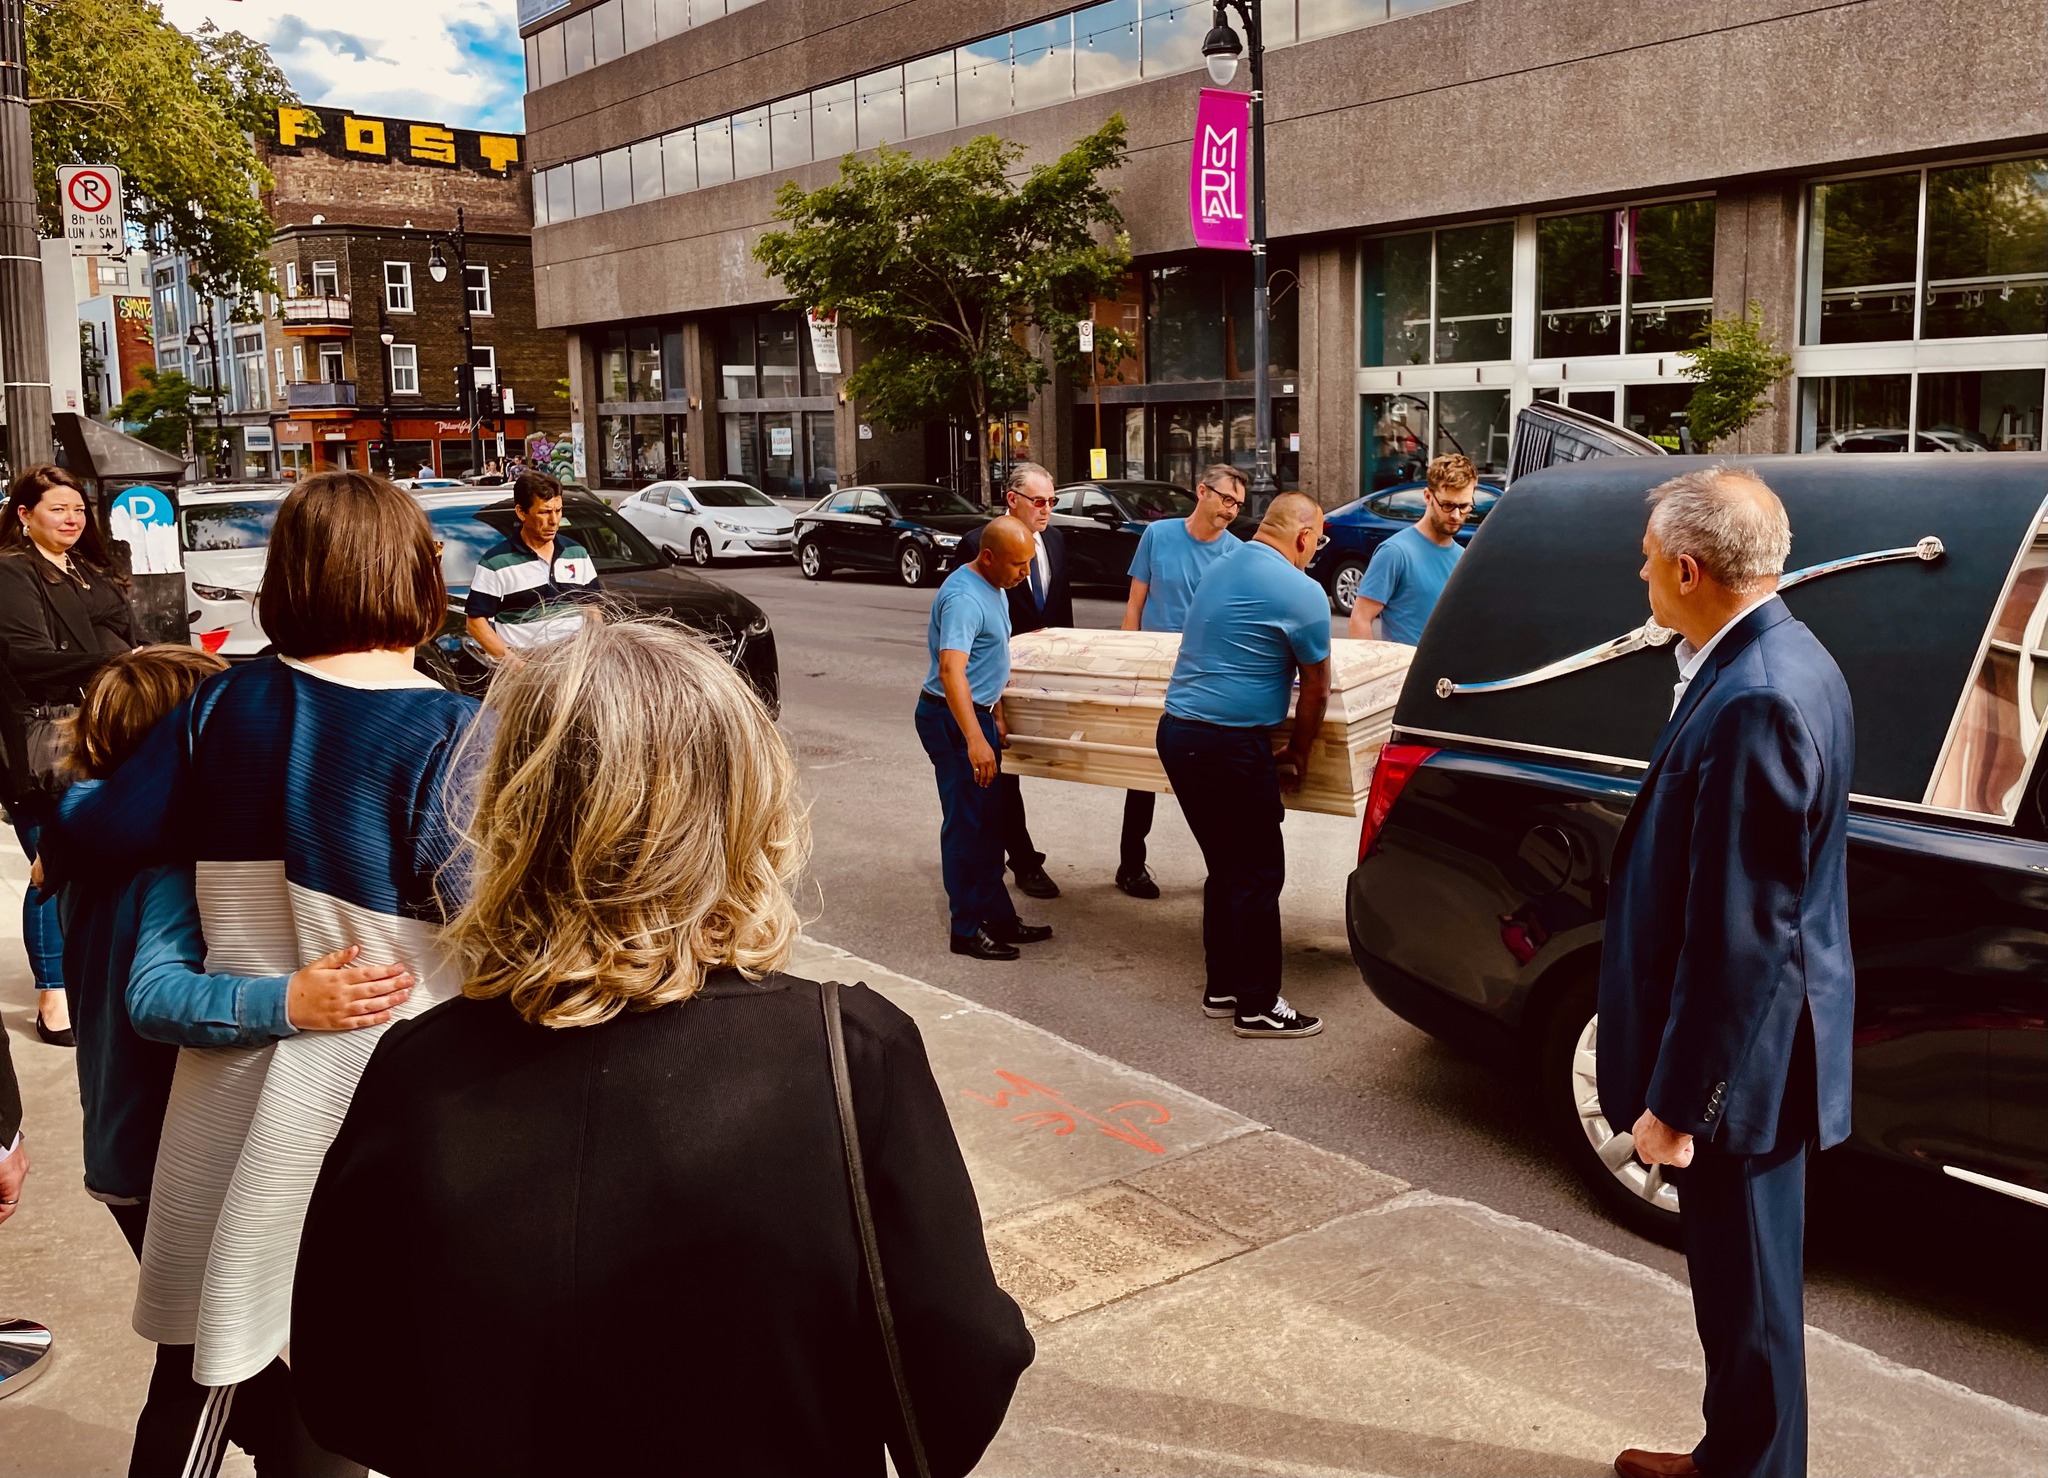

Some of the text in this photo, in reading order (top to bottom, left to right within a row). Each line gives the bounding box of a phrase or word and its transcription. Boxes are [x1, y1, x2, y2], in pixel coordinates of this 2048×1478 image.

[279, 106, 518, 172] POST
[84, 180, 99, 201] P
[68, 228, 85, 239] LUN
[100, 228, 118, 239] SAM
